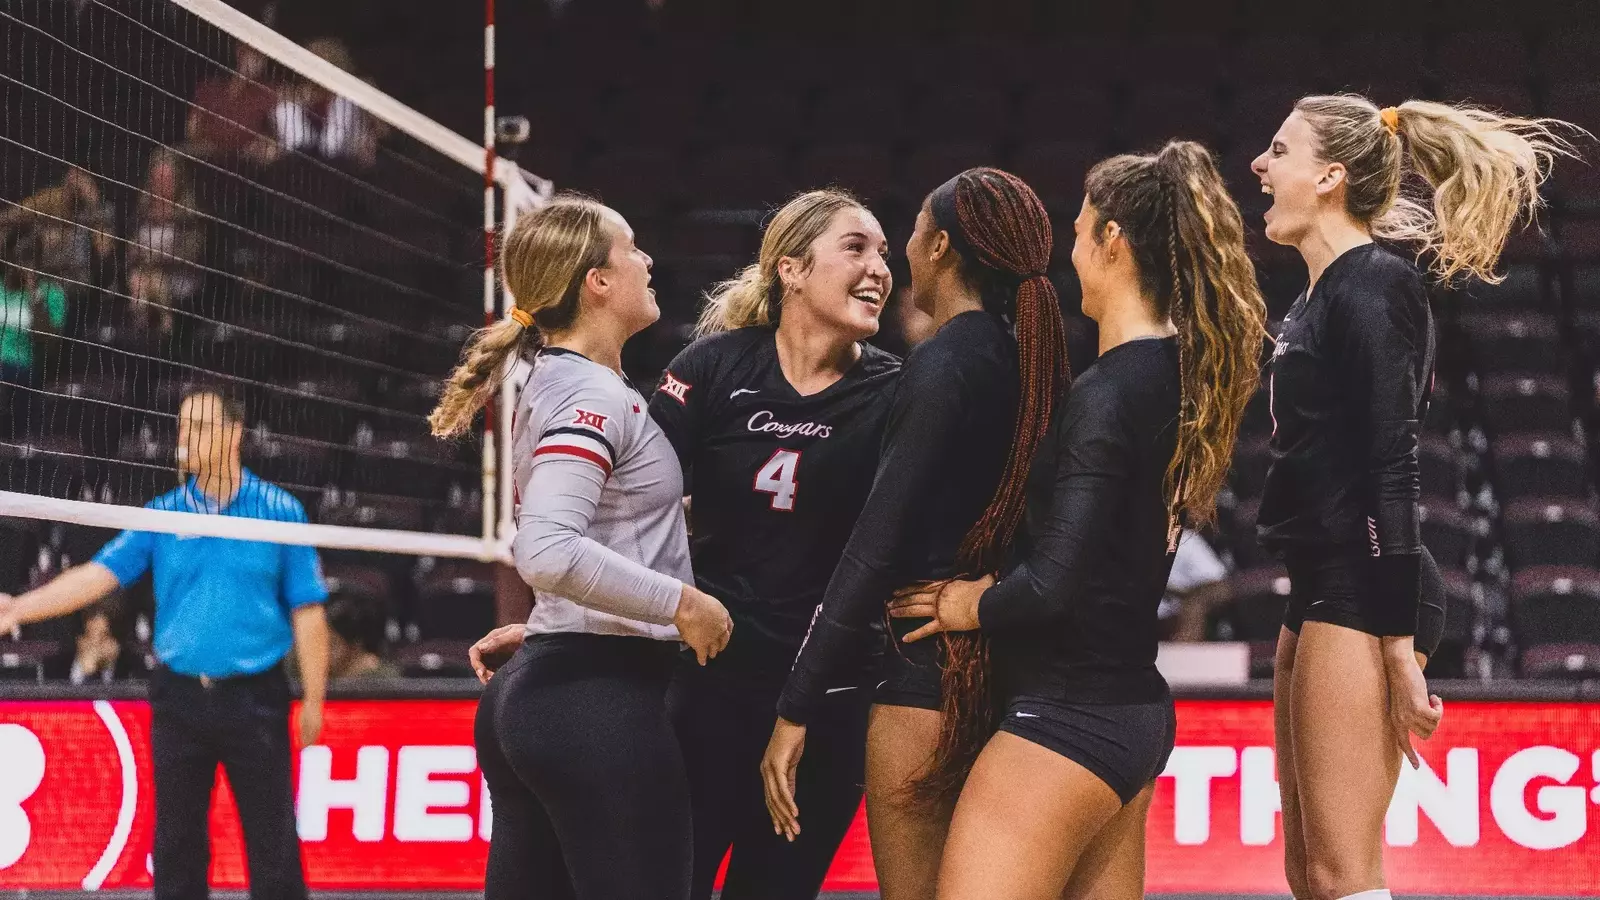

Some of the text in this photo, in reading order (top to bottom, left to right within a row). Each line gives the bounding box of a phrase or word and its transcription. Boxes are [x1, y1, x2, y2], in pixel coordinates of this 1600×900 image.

[659, 372, 692, 405] XII
[572, 408, 608, 432] XII
[747, 410, 833, 439] Cougars
[753, 448, 802, 512] 4
[297, 744, 493, 842] HE
